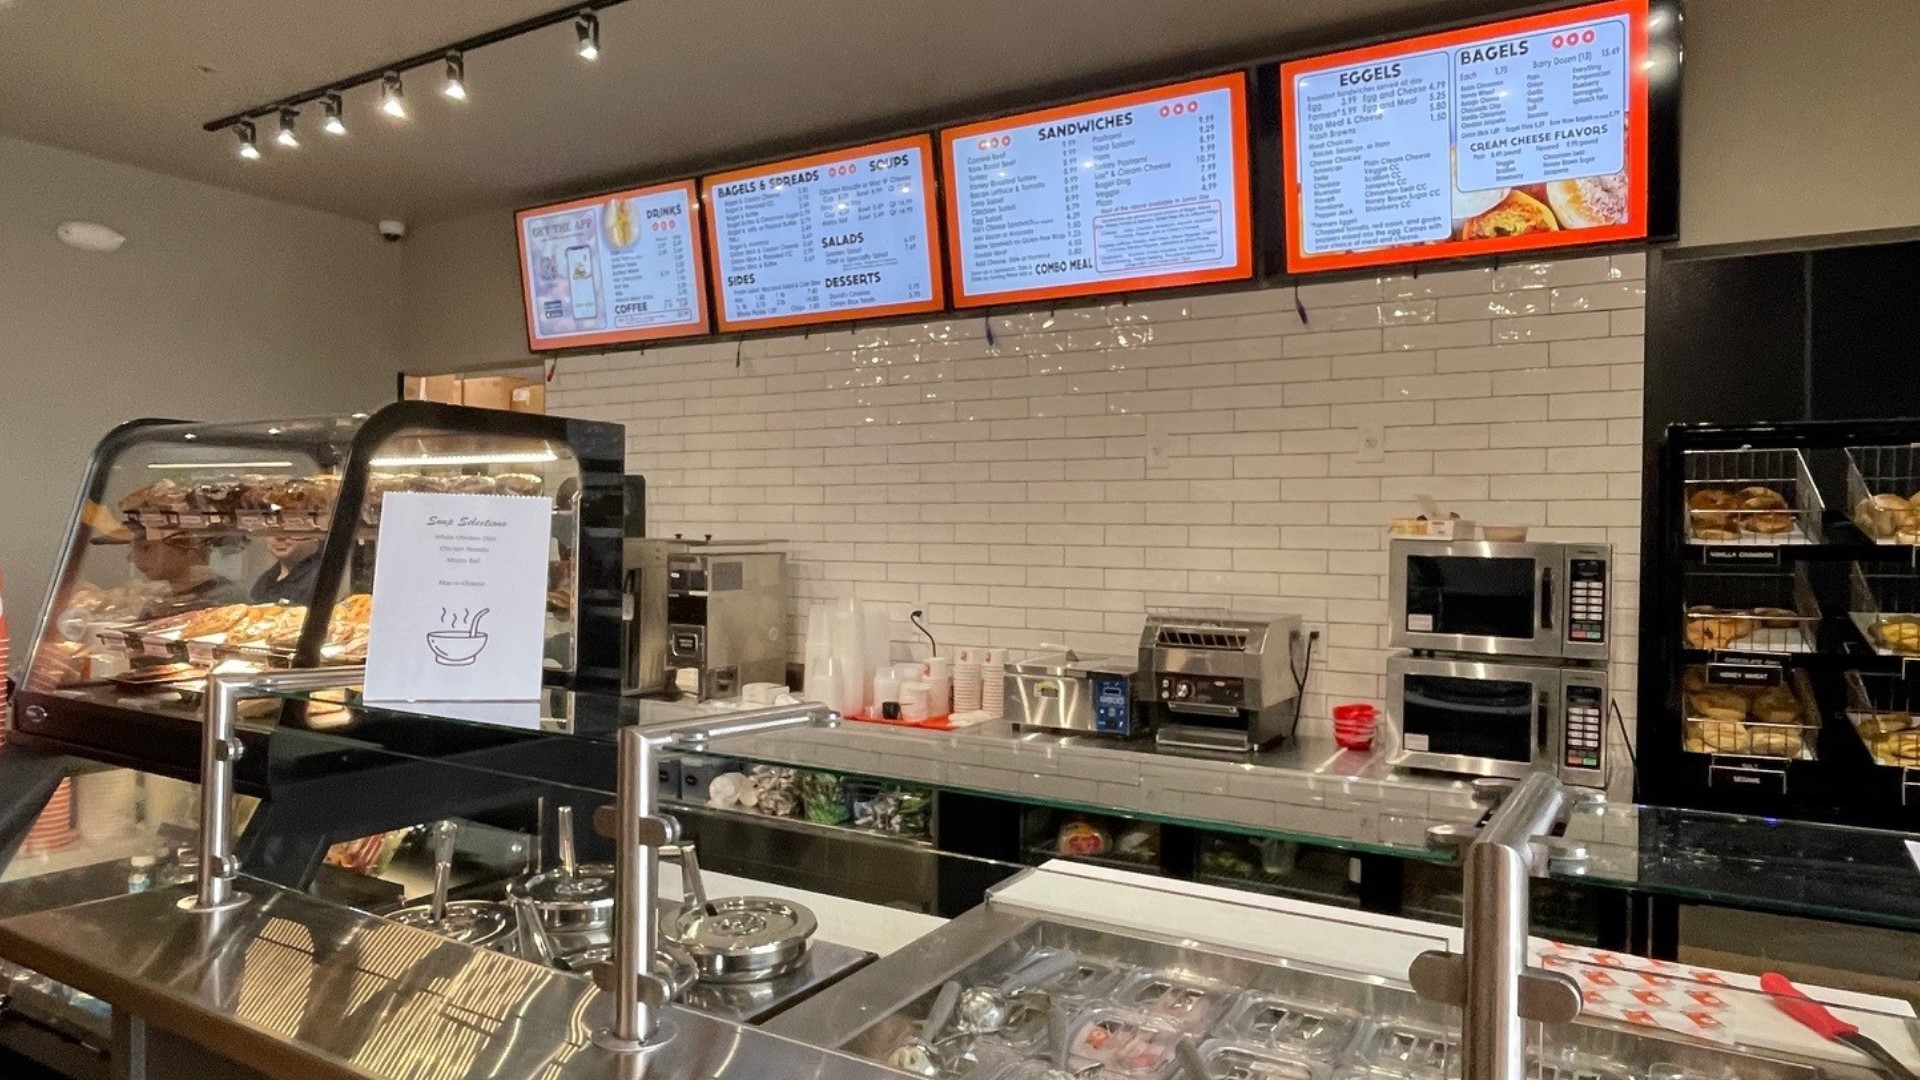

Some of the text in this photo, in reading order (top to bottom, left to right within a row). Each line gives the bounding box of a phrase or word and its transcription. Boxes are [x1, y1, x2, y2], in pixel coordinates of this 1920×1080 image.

[1461, 40, 1529, 66] BAGELS
[1340, 63, 1402, 87] EGGELS
[1460, 72, 1477, 81] Each
[1308, 102, 1322, 113] Egg
[1363, 93, 1377, 104] Egg
[1397, 84, 1427, 96] Cheese
[1039, 113, 1133, 141] SANDWICHES
[1309, 122, 1323, 132] Egg
[1471, 124, 1607, 152] CREAM CHEESE FLAVORS
[869, 154, 909, 172] SOUPS
[718, 170, 820, 199] BAGELS & SPREADS
[647, 204, 682, 219] DRINKS
[532, 226, 550, 238] GET
[554, 222, 571, 234] THE
[822, 232, 864, 248] SALADS
[1036, 261, 1067, 275] COMBO
[1070, 258, 1092, 271] MEAL
[728, 274, 755, 286] SIDES
[825, 272, 881, 289] DESSERTS
[615, 302, 648, 314] COFFEE
[426, 516, 506, 527] Soup Selections
